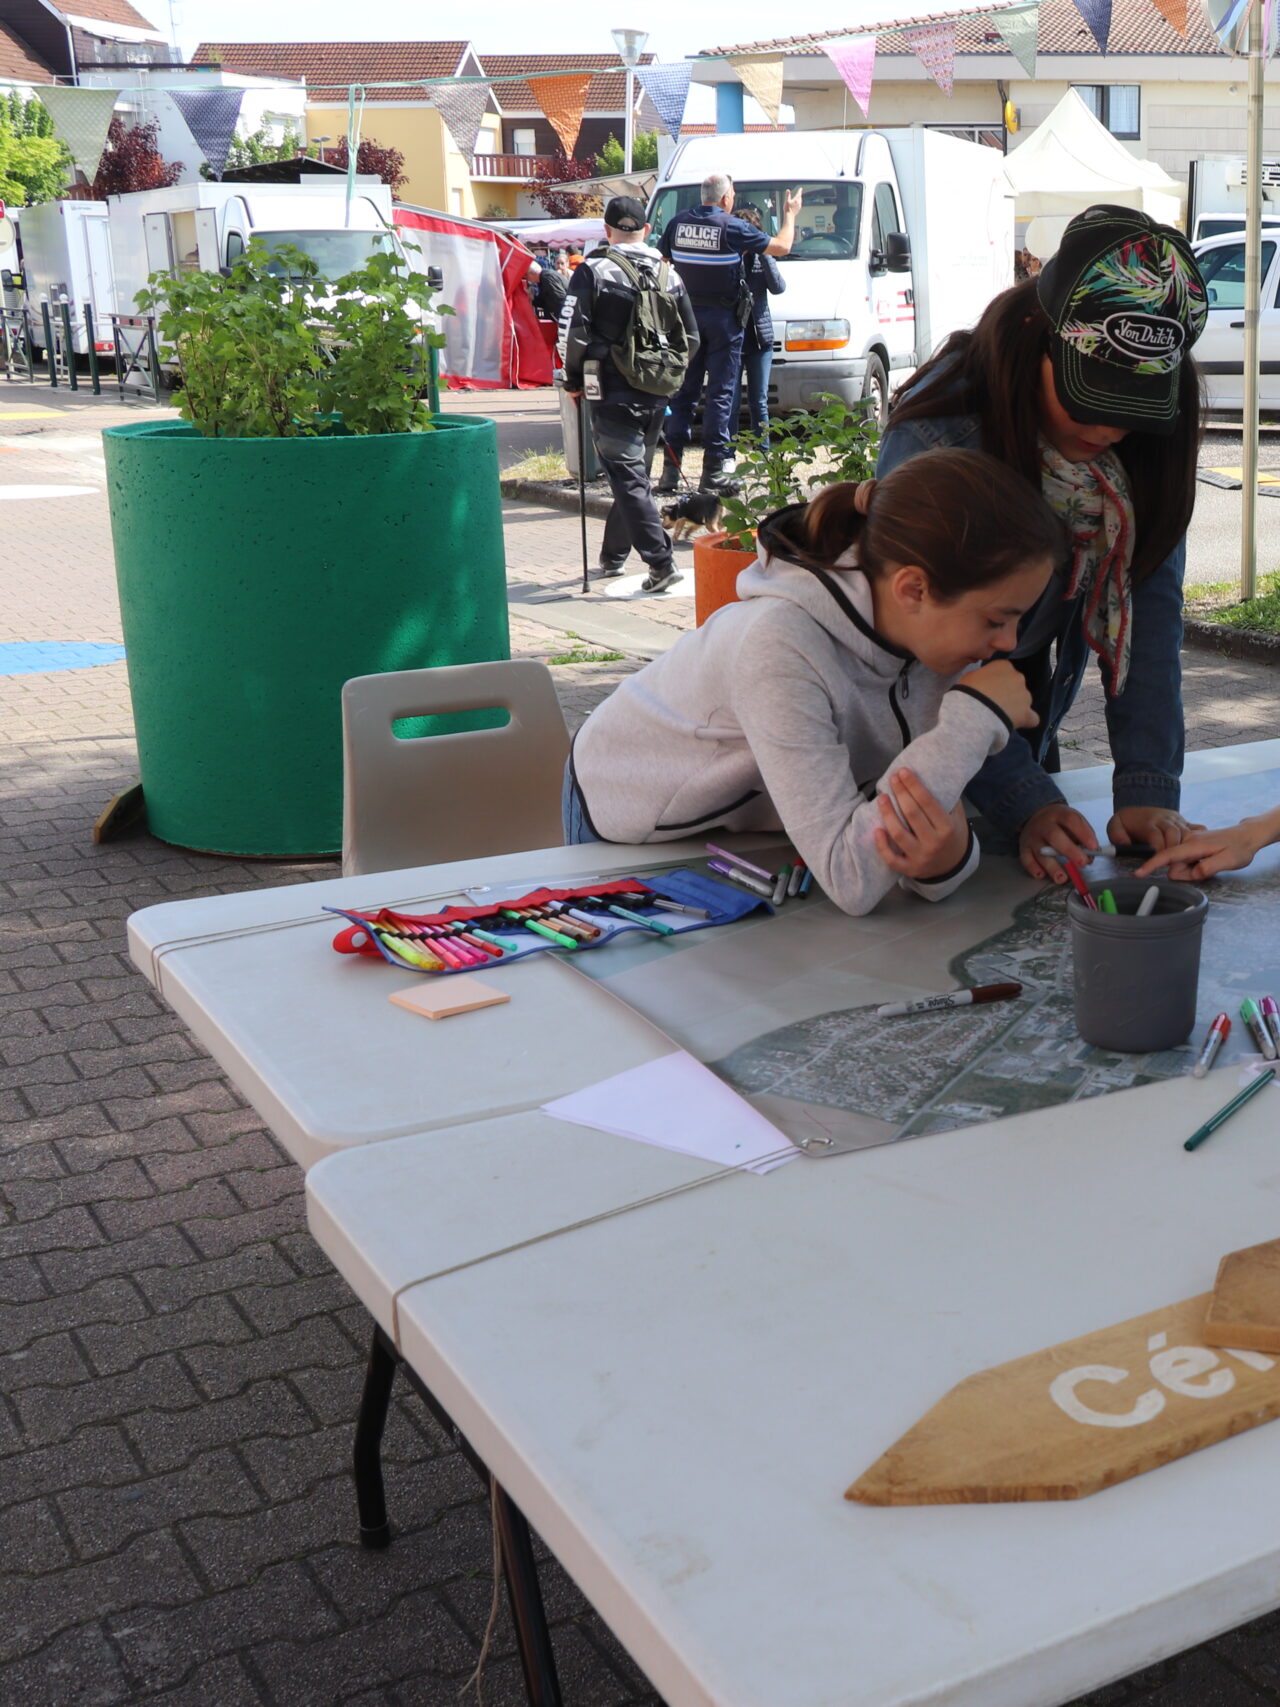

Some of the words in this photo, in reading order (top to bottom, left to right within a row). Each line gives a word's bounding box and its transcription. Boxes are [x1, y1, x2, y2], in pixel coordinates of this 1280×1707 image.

[677, 225, 719, 241] POLICE
[677, 237, 718, 248] MUNICIPALE
[1118, 318, 1141, 343] Von
[1140, 325, 1176, 349] Dutch
